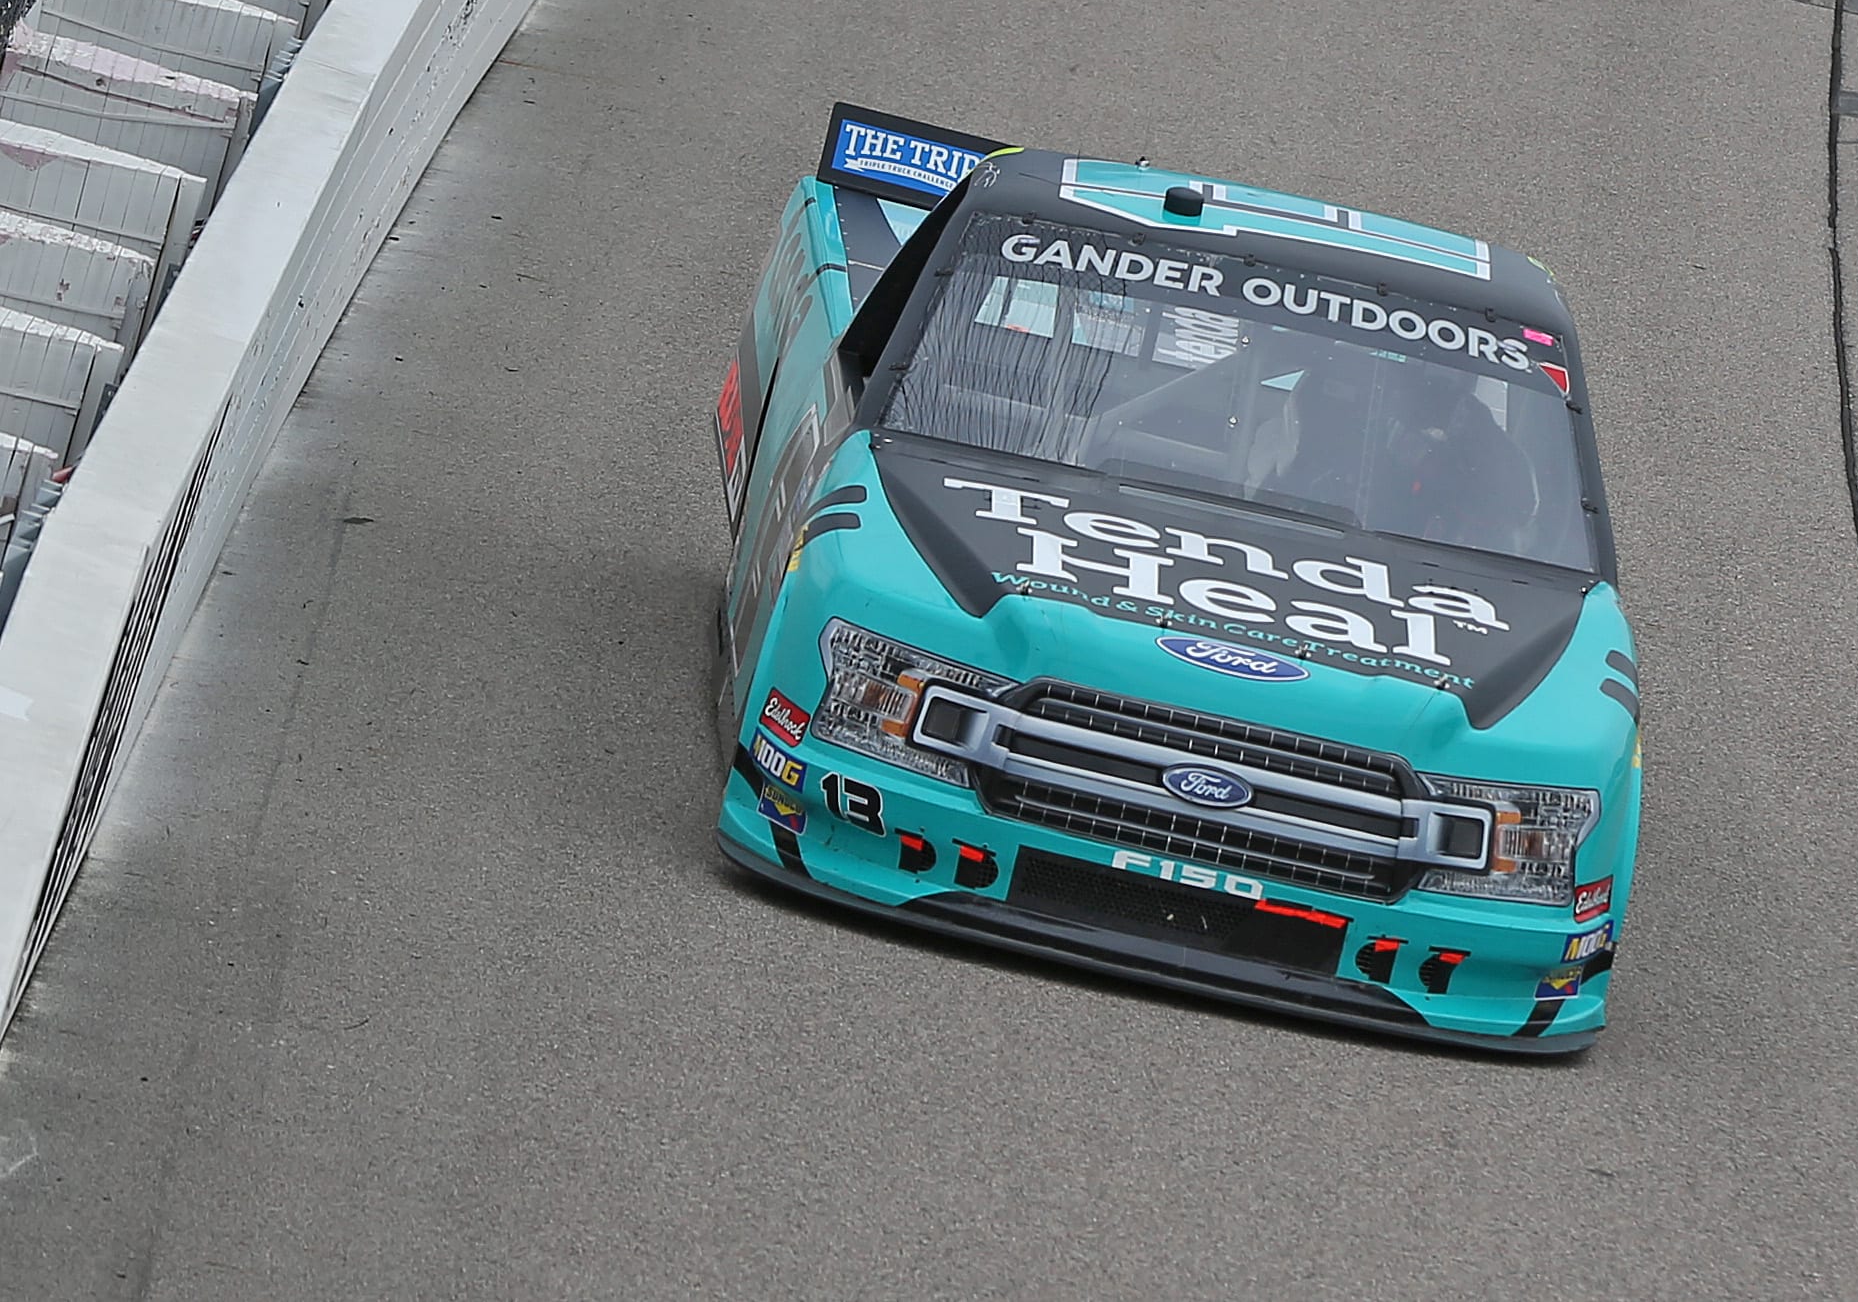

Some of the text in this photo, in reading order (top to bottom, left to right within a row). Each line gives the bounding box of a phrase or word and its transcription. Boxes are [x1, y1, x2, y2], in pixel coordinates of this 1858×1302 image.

[844, 123, 905, 160] THE
[859, 158, 887, 171] TRIPLE
[888, 164, 911, 176] TRUCK
[1001, 234, 1530, 371] GANDER OUTDOORS
[943, 476, 1510, 631] Tenda
[1016, 526, 1452, 667] Heal
[990, 570, 1476, 690] Wound & Skin Care Treatment
[1185, 639, 1278, 675] Ford
[764, 697, 807, 741] Edelbrock
[753, 732, 803, 787] MOOG
[1180, 771, 1234, 801] Ford
[820, 770, 887, 838] 13
[1111, 849, 1264, 901] F150
